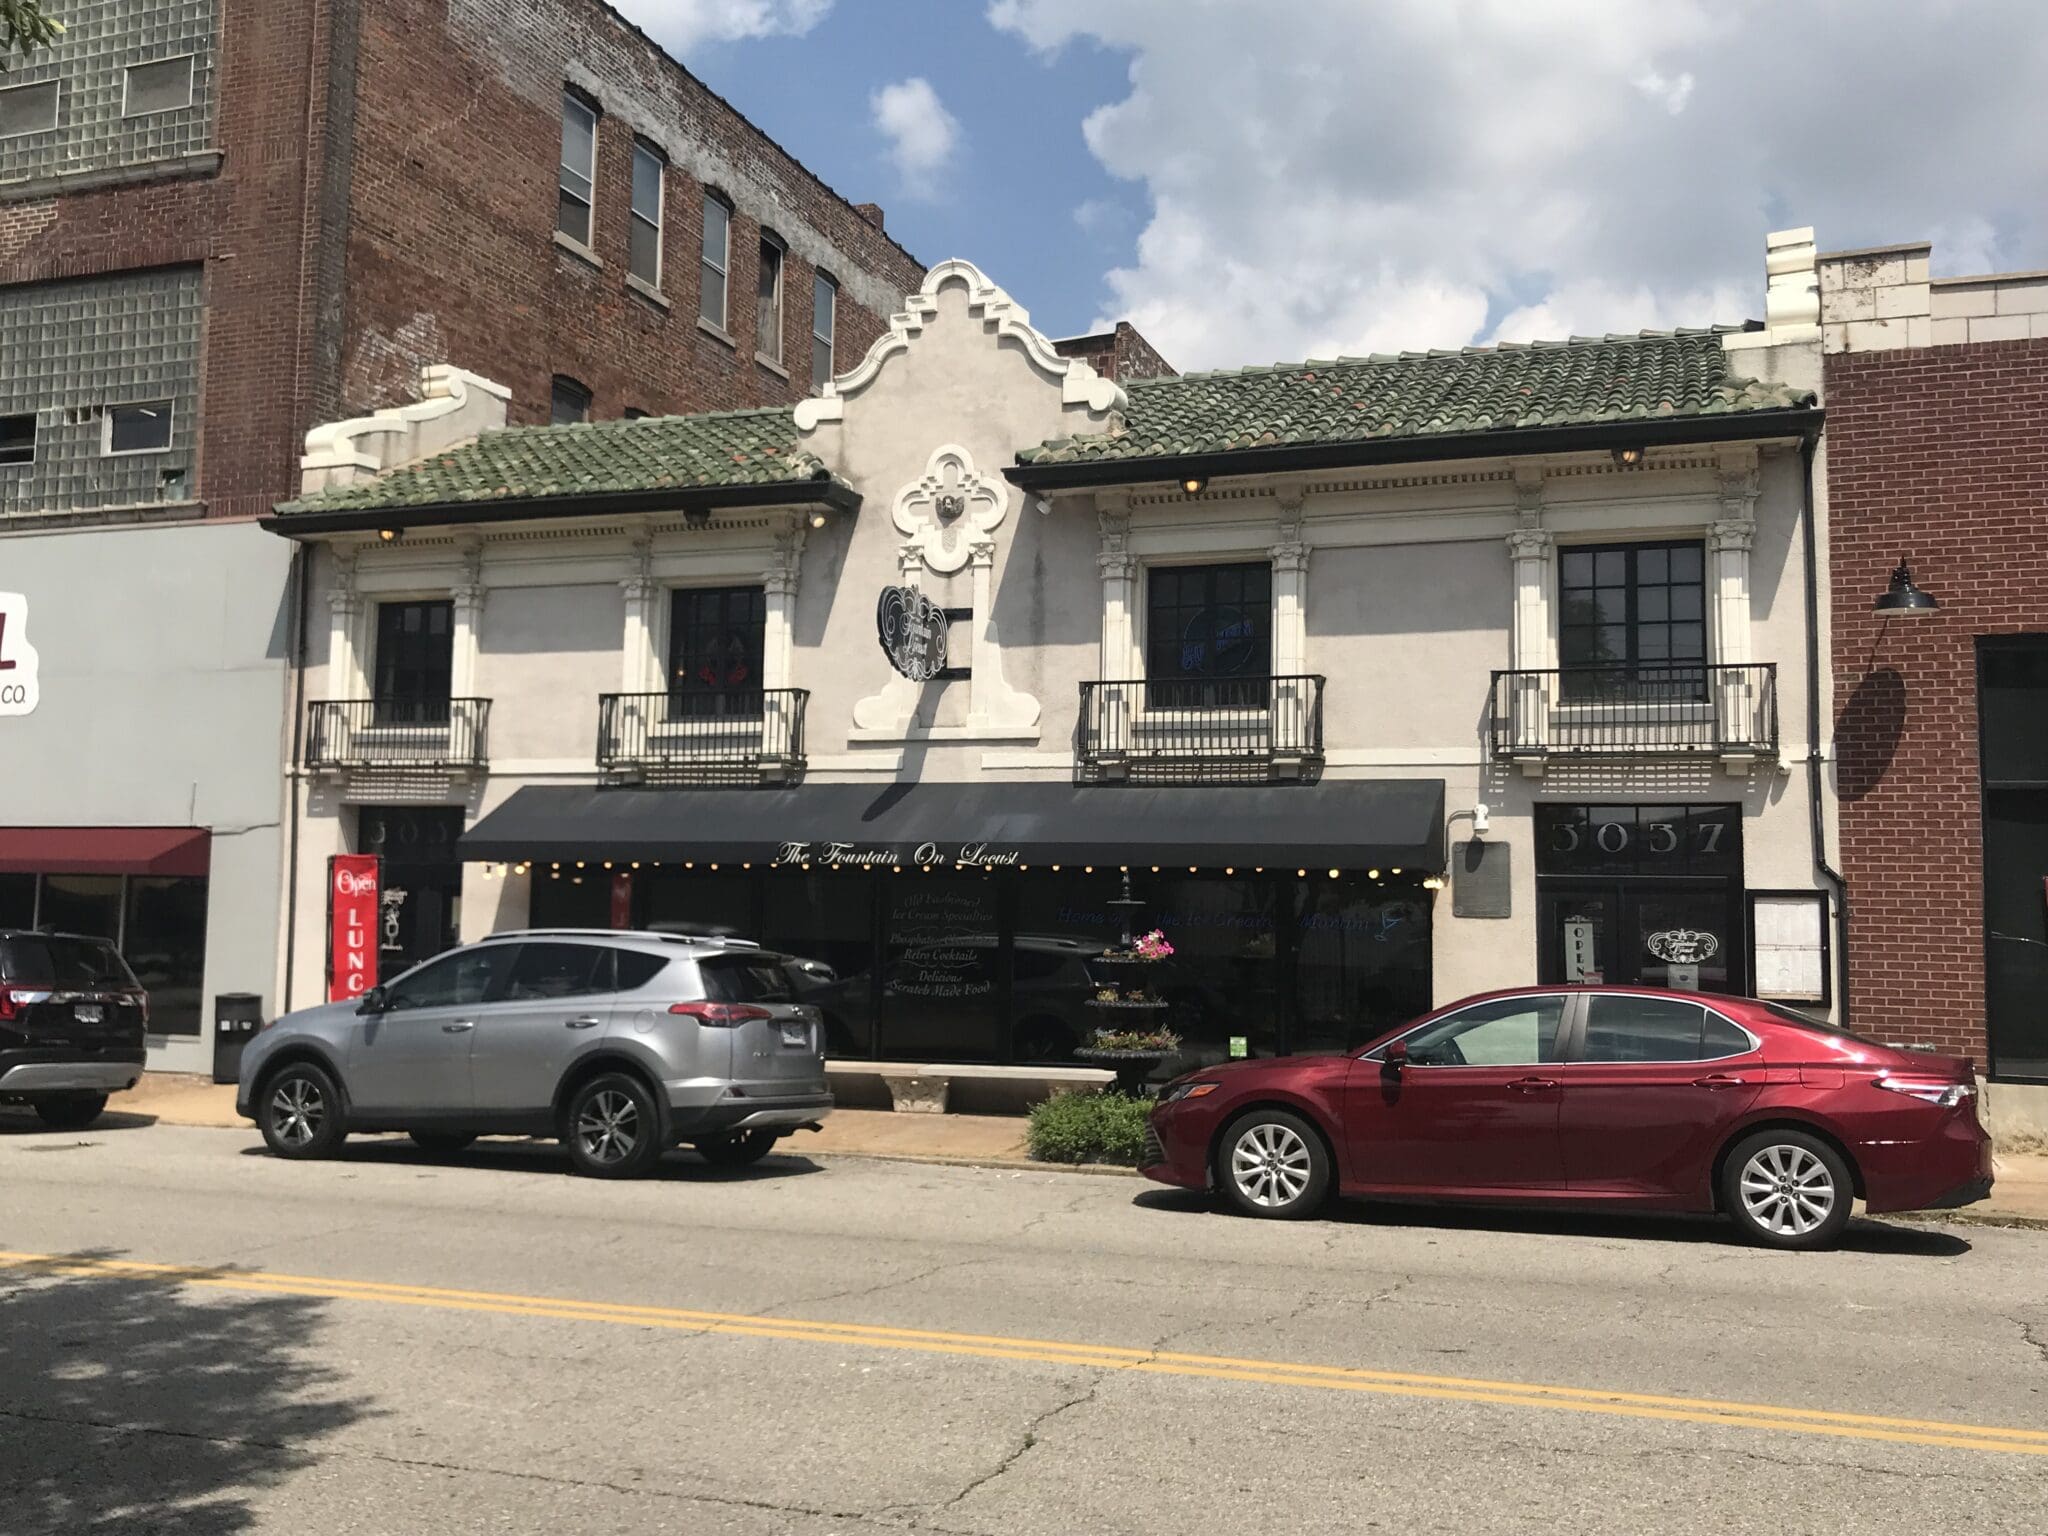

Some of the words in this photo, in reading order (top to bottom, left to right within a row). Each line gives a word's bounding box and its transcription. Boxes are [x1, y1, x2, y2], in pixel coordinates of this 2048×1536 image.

[1552, 822, 1724, 852] 3037
[776, 842, 810, 864] The
[818, 842, 898, 864] Fountain
[914, 842, 946, 864] On
[956, 842, 1019, 866] Locust
[336, 869, 377, 897] Open
[1057, 906, 1105, 923] Home
[348, 908, 364, 1000] LUNC
[933, 949, 977, 961] Cocktails
[1574, 928, 1584, 977] OPEN
[919, 971, 962, 982] Delicious
[965, 981, 990, 995] Food
